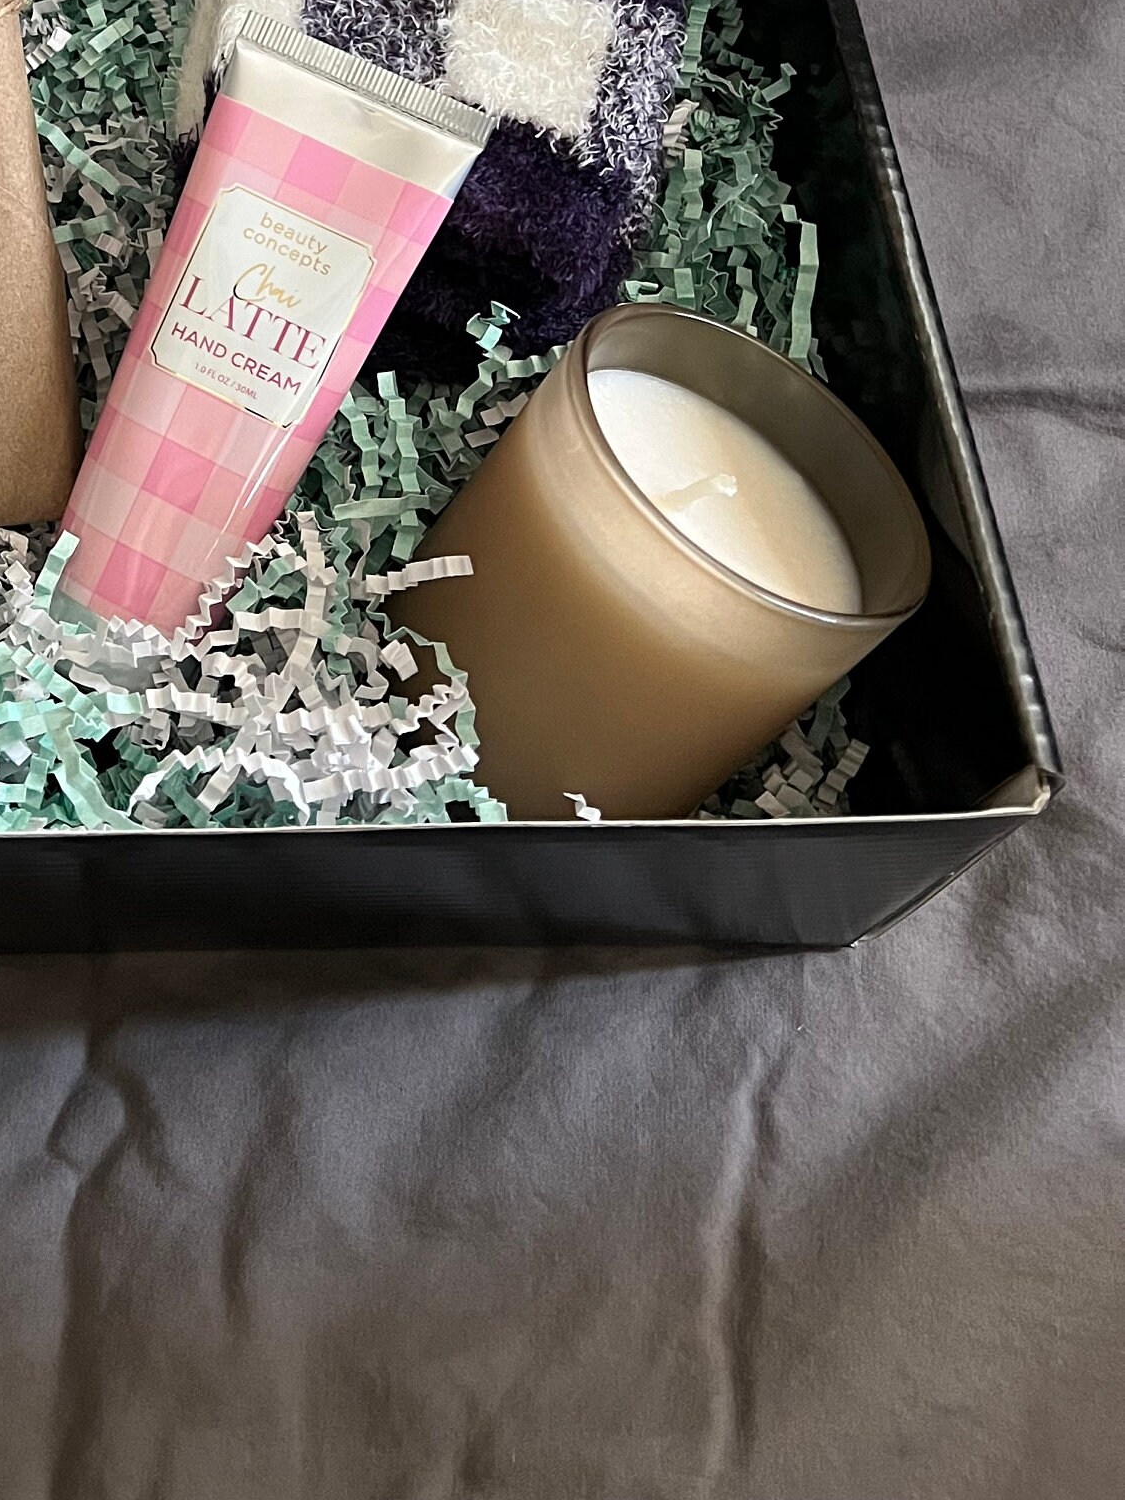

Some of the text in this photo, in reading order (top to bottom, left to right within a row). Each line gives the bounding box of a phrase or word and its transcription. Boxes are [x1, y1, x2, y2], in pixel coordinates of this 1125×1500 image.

[243, 227, 332, 276] concepts
[260, 211, 328, 256] beauty
[233, 262, 301, 309] Chai
[178, 274, 327, 370] LATTE
[171, 321, 302, 396] HAND CREAM
[206, 368, 217, 380] FL
[217, 374, 230, 386] OZ
